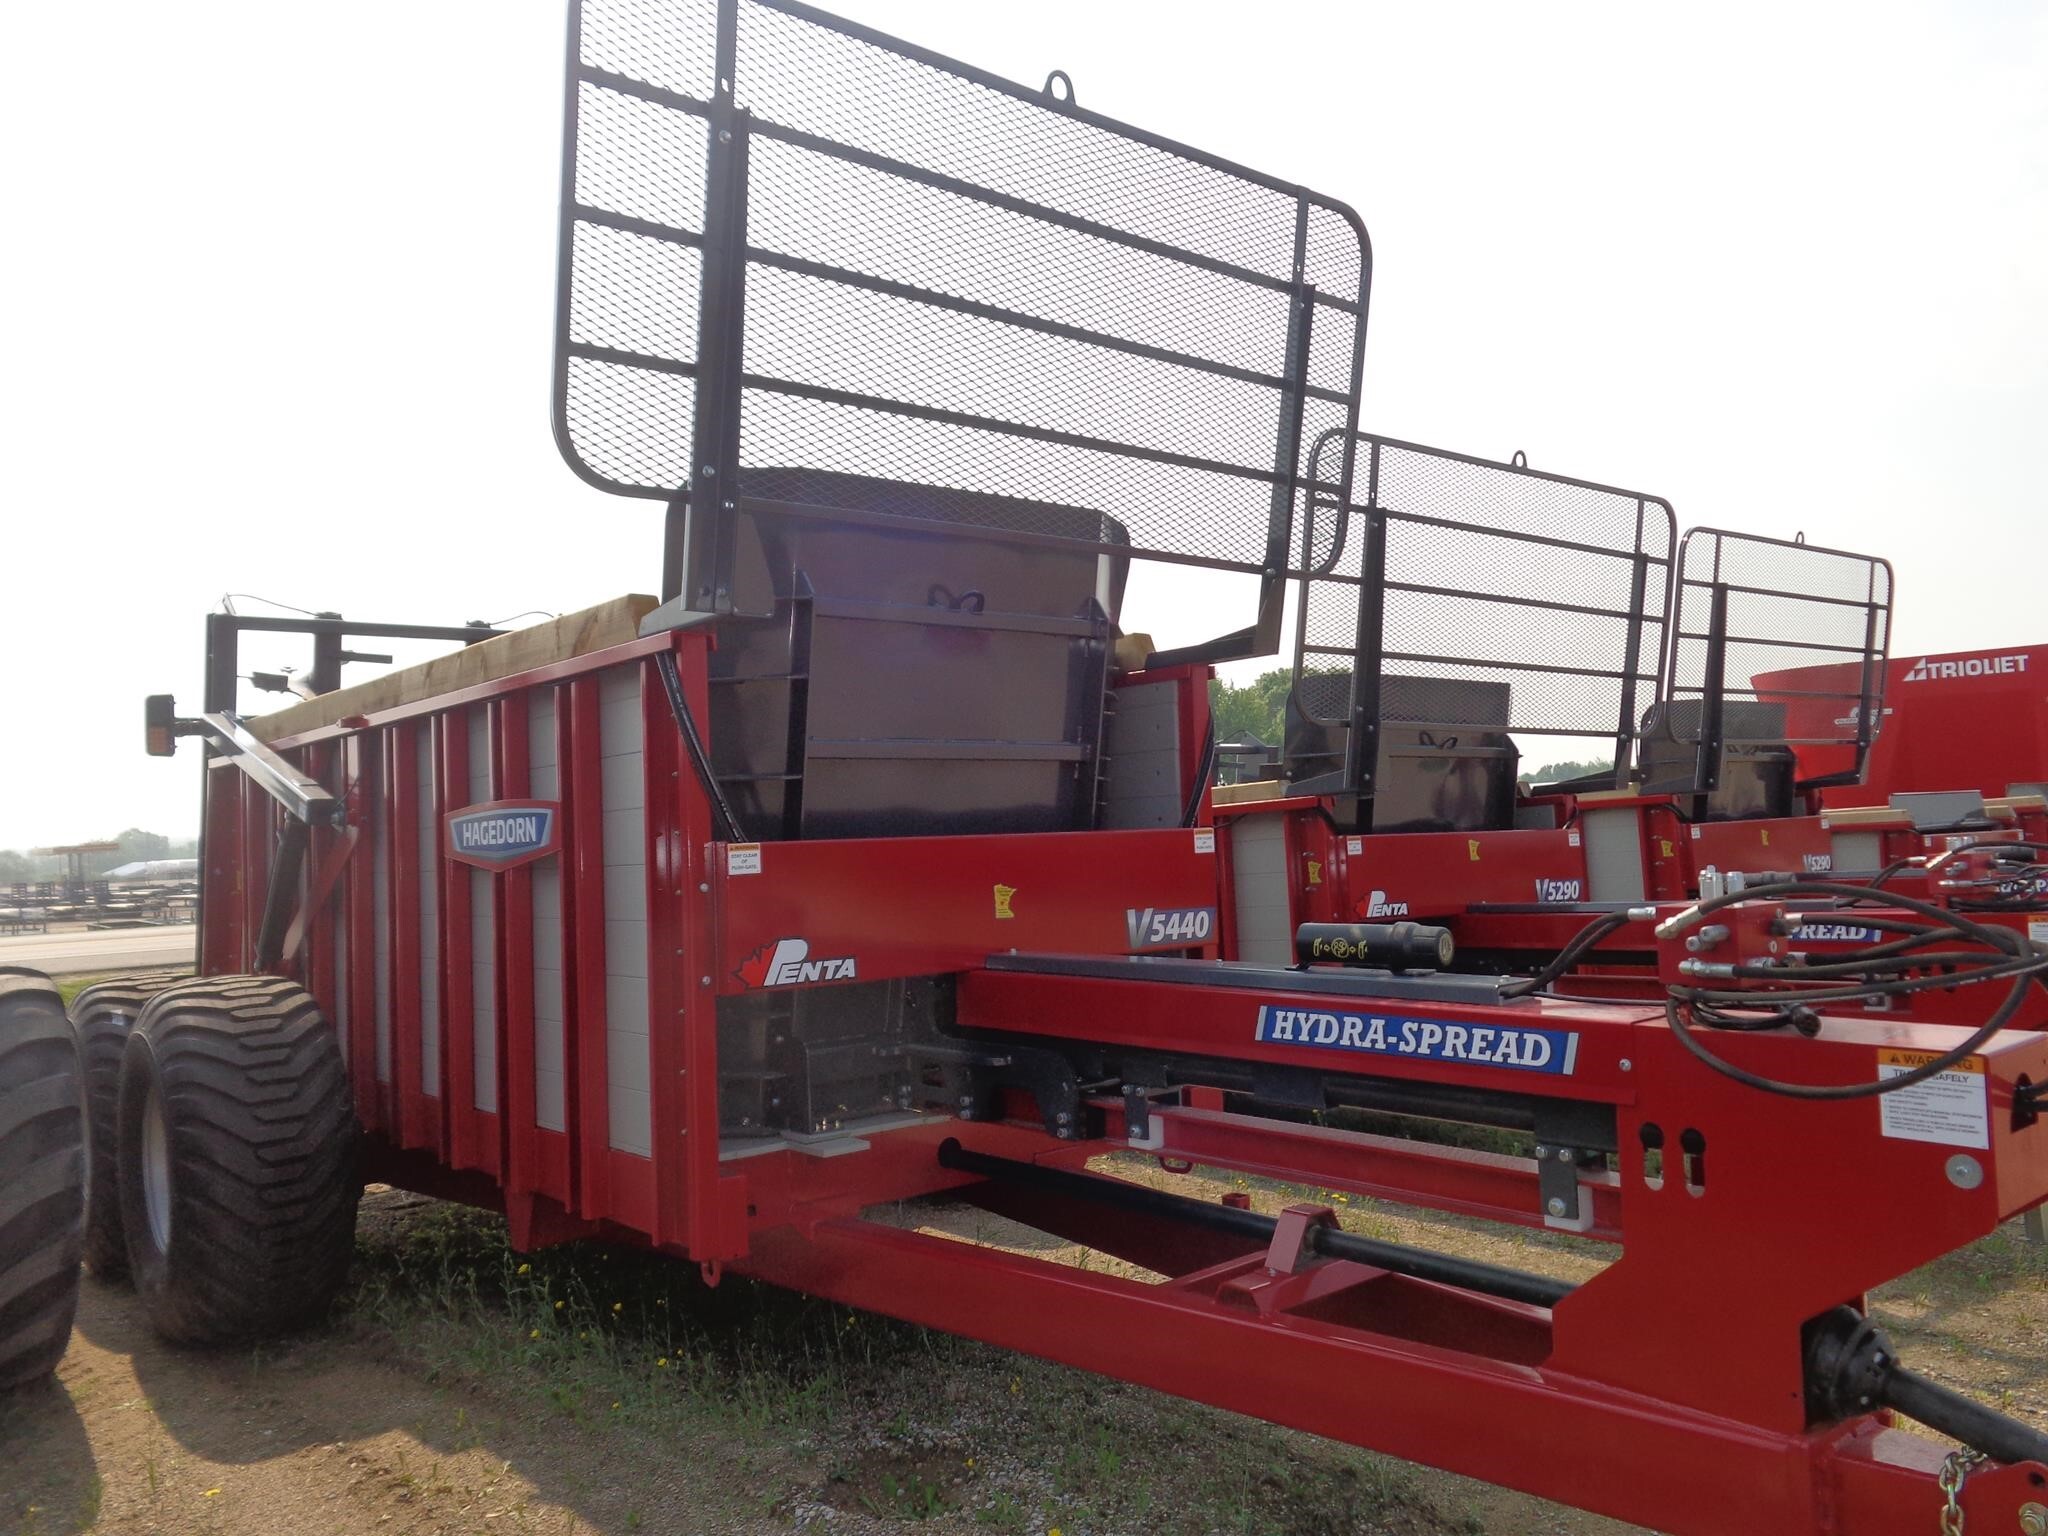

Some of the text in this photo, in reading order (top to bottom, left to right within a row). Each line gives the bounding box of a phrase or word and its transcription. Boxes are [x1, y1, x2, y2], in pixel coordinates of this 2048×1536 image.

[1927, 655, 2029, 679] TRIOLIET
[463, 816, 537, 847] HAGEDORN
[1366, 890, 1408, 918] PENTA
[1535, 878, 1580, 902] V5290
[1126, 907, 1210, 949] V5440
[763, 939, 856, 987] PENTA
[1271, 1010, 1551, 1067] HYDRA-SPREAD
